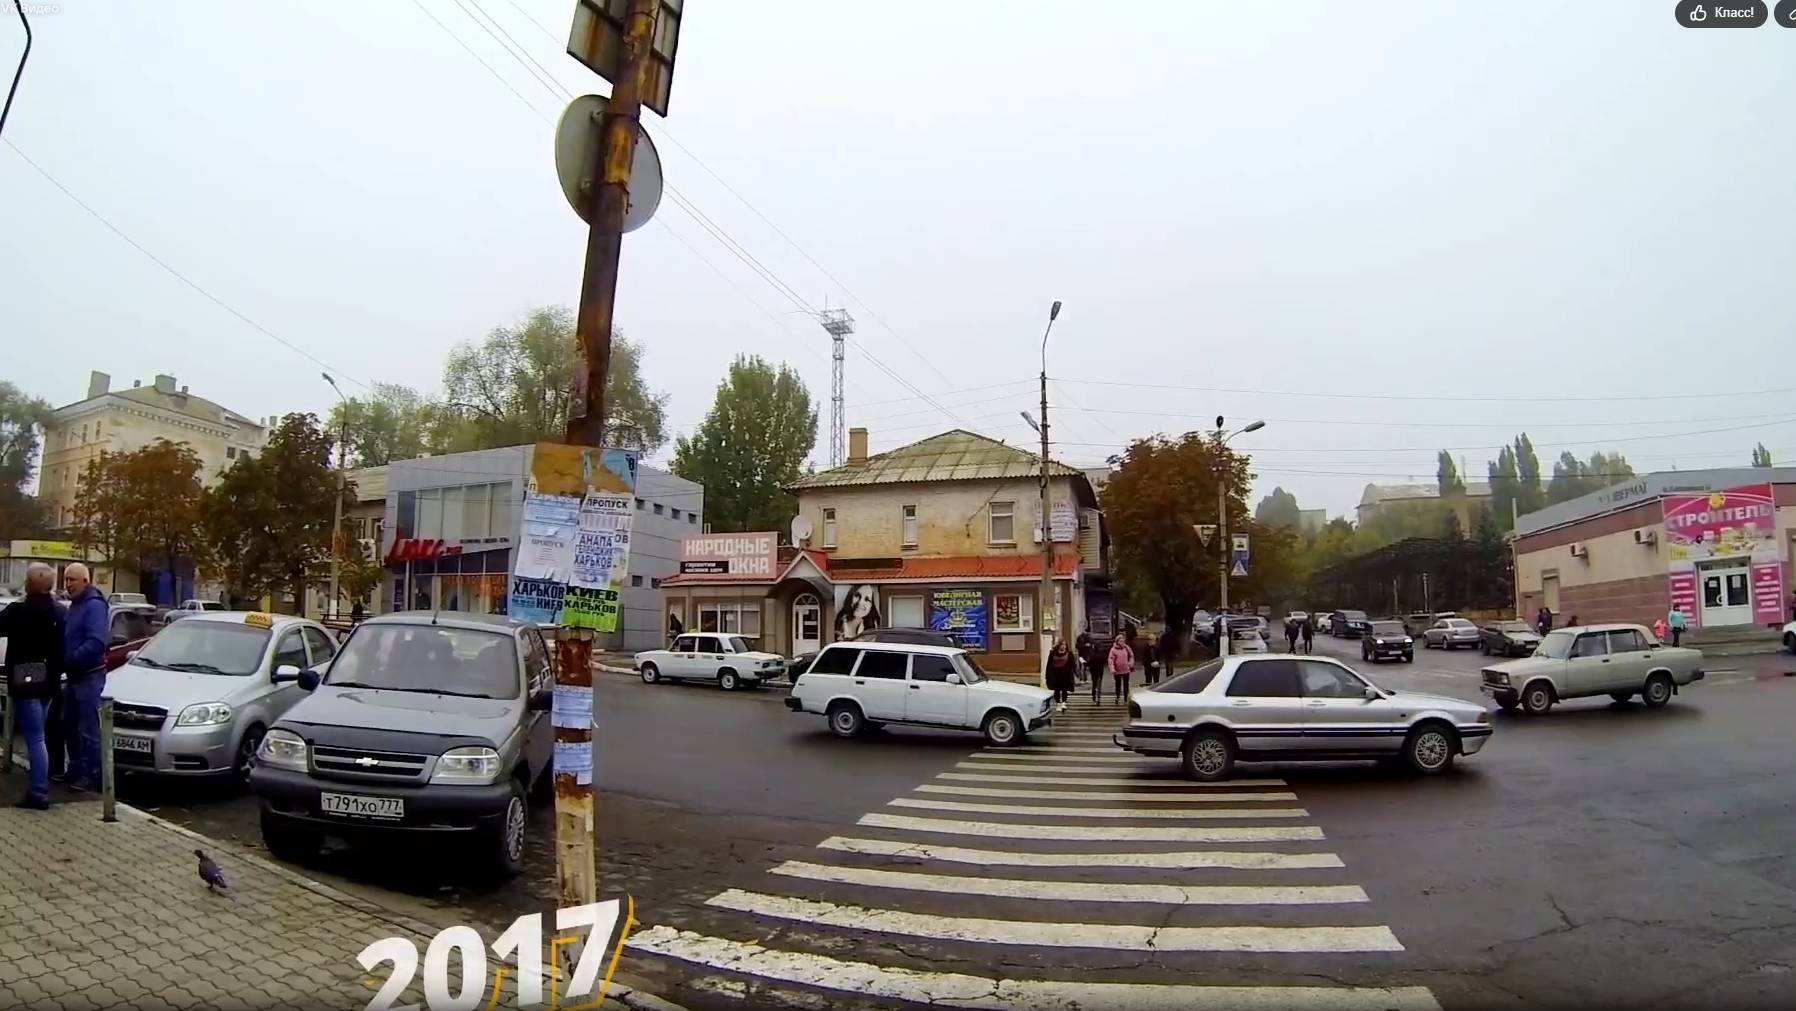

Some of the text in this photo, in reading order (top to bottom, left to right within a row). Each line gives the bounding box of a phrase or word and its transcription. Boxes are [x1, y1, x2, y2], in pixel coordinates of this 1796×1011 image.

[587, 498, 627, 510] ПРОПУСК
[1664, 503, 1775, 531] СТРОИТЕЛЬ
[578, 534, 611, 547] АНАПА
[685, 537, 769, 556] НАРОДНЫЕ
[573, 554, 611, 568] ХАРЬКОВ
[728, 556, 769, 573] ОКНА
[513, 581, 565, 600] ХАРЬКОВ
[566, 586, 619, 602] КИЕВ
[565, 600, 618, 615] ХАРЬКОВ
[325, 796, 401, 813] Т791ХО 777
